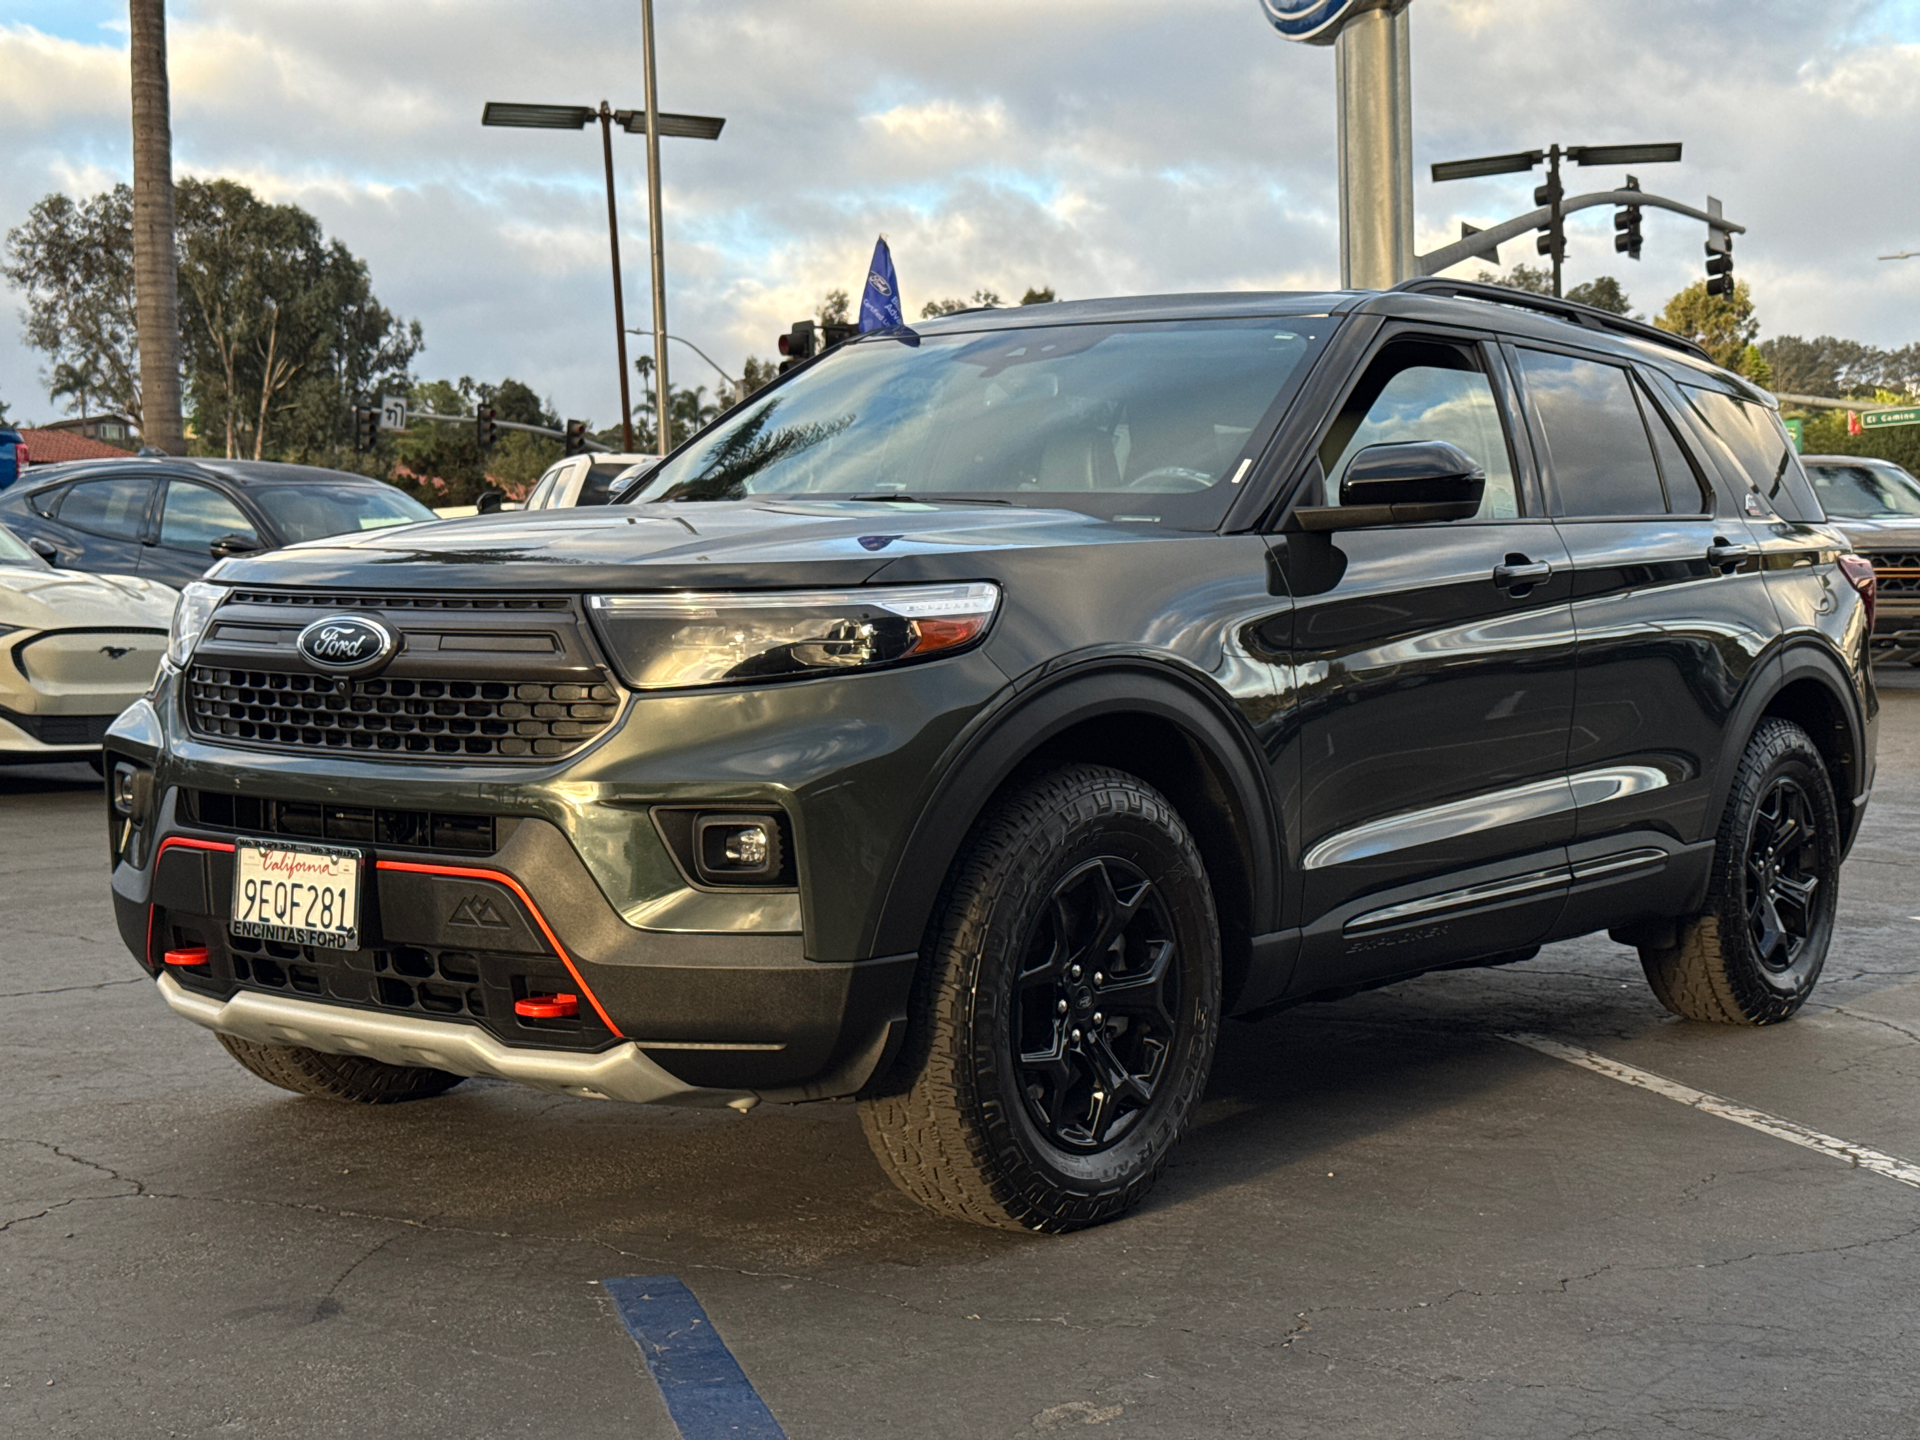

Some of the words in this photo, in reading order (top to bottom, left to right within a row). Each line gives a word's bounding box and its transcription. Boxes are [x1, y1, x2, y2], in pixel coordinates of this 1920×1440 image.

[314, 626, 366, 657] Ford
[262, 850, 338, 879] California
[243, 878, 348, 931] 9EQF281
[233, 920, 306, 944] ENCINITAS
[309, 932, 347, 948] FORD
